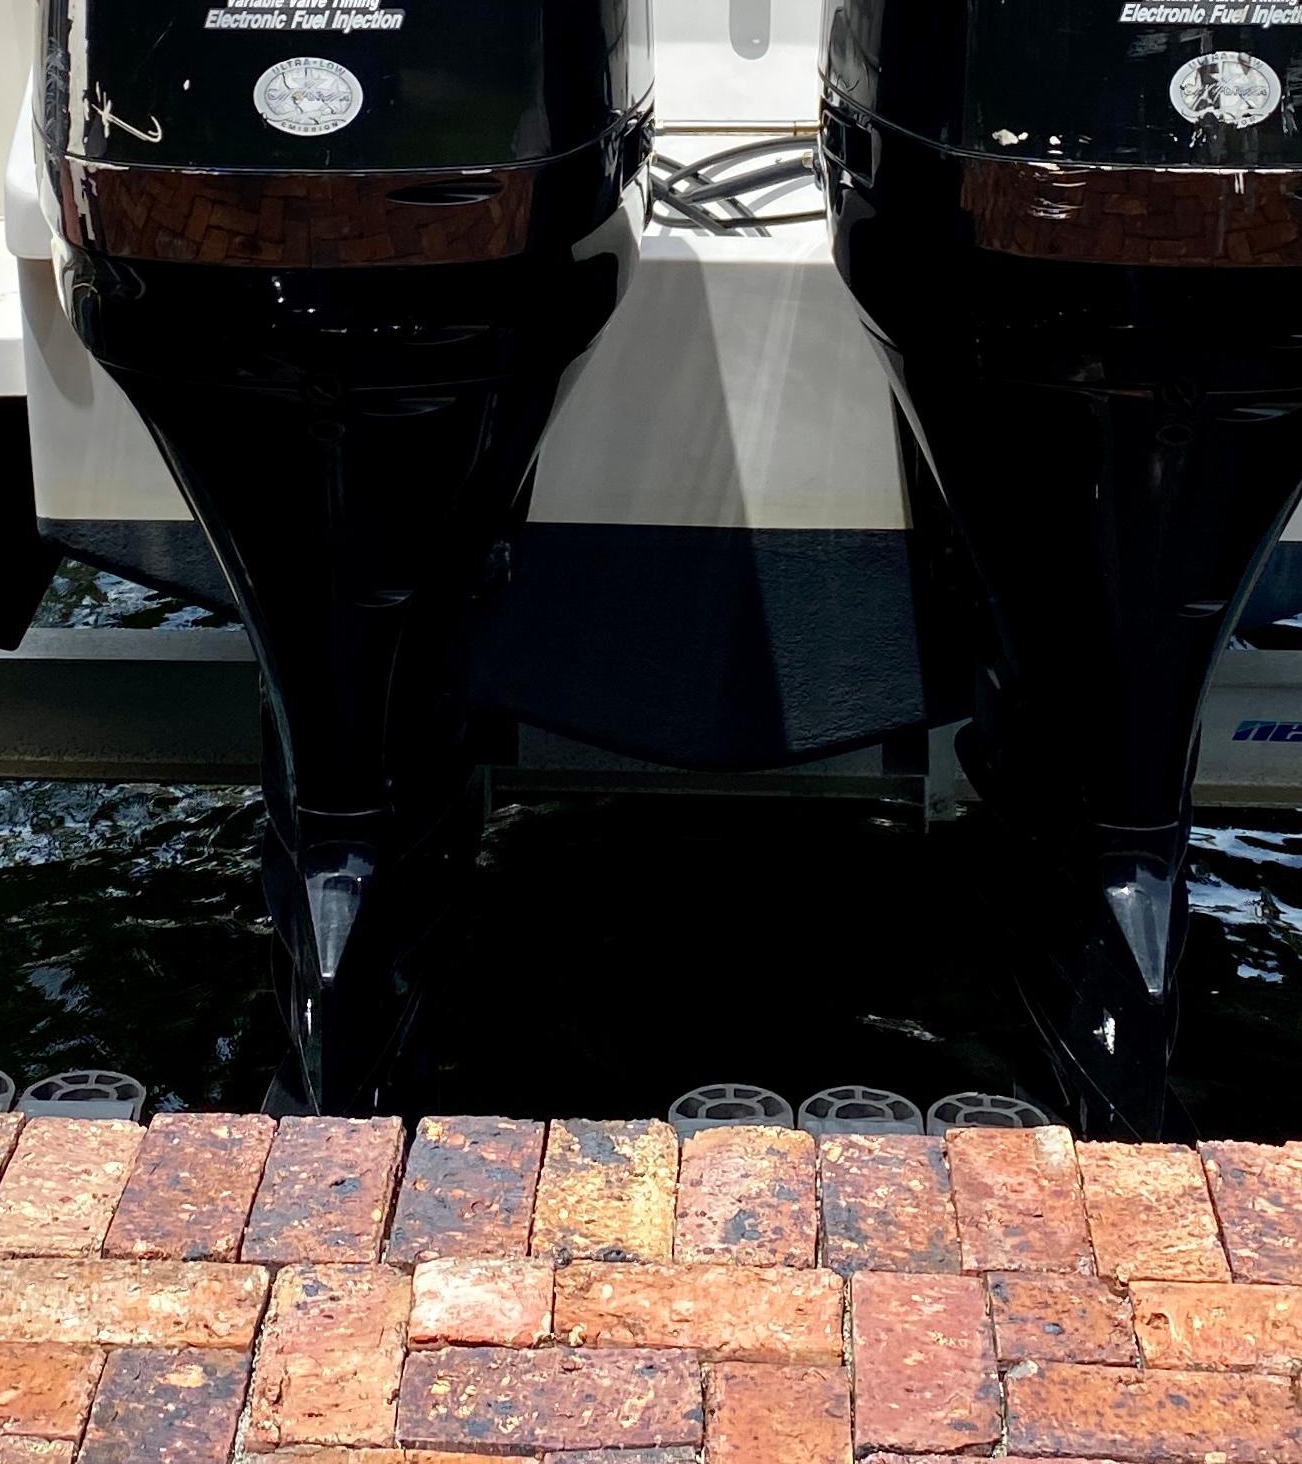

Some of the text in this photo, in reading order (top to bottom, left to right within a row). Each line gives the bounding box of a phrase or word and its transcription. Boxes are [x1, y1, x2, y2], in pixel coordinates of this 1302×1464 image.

[205, 10, 404, 35] Electronic Fuel Injection
[1120, 4, 1207, 23] Electronic
[1210, 4, 1248, 24] Fuel
